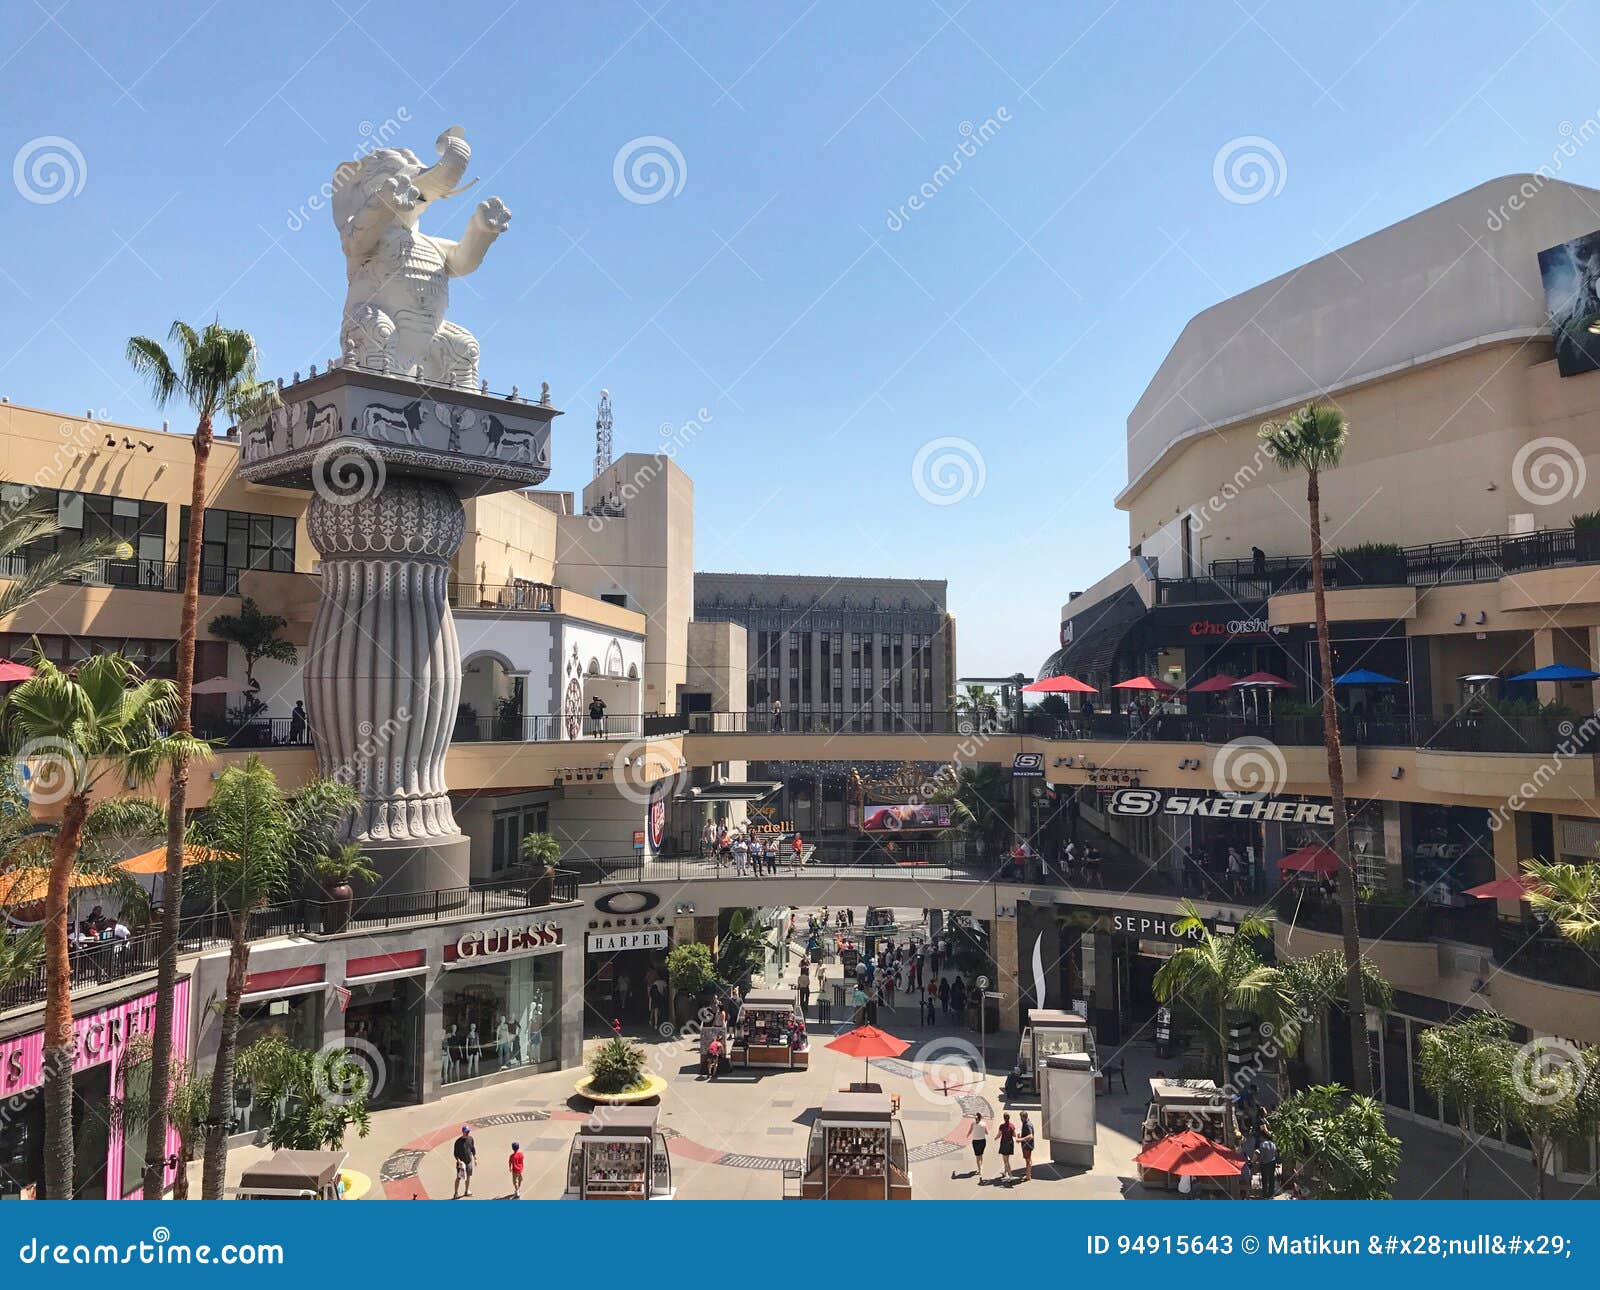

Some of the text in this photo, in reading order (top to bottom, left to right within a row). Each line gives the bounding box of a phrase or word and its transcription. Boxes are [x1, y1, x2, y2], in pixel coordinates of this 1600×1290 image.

[1163, 796, 1335, 825] SKECHERS
[457, 920, 559, 960] GUESS
[595, 933, 661, 949] HARPER
[42, 1003, 157, 1067] CRET
